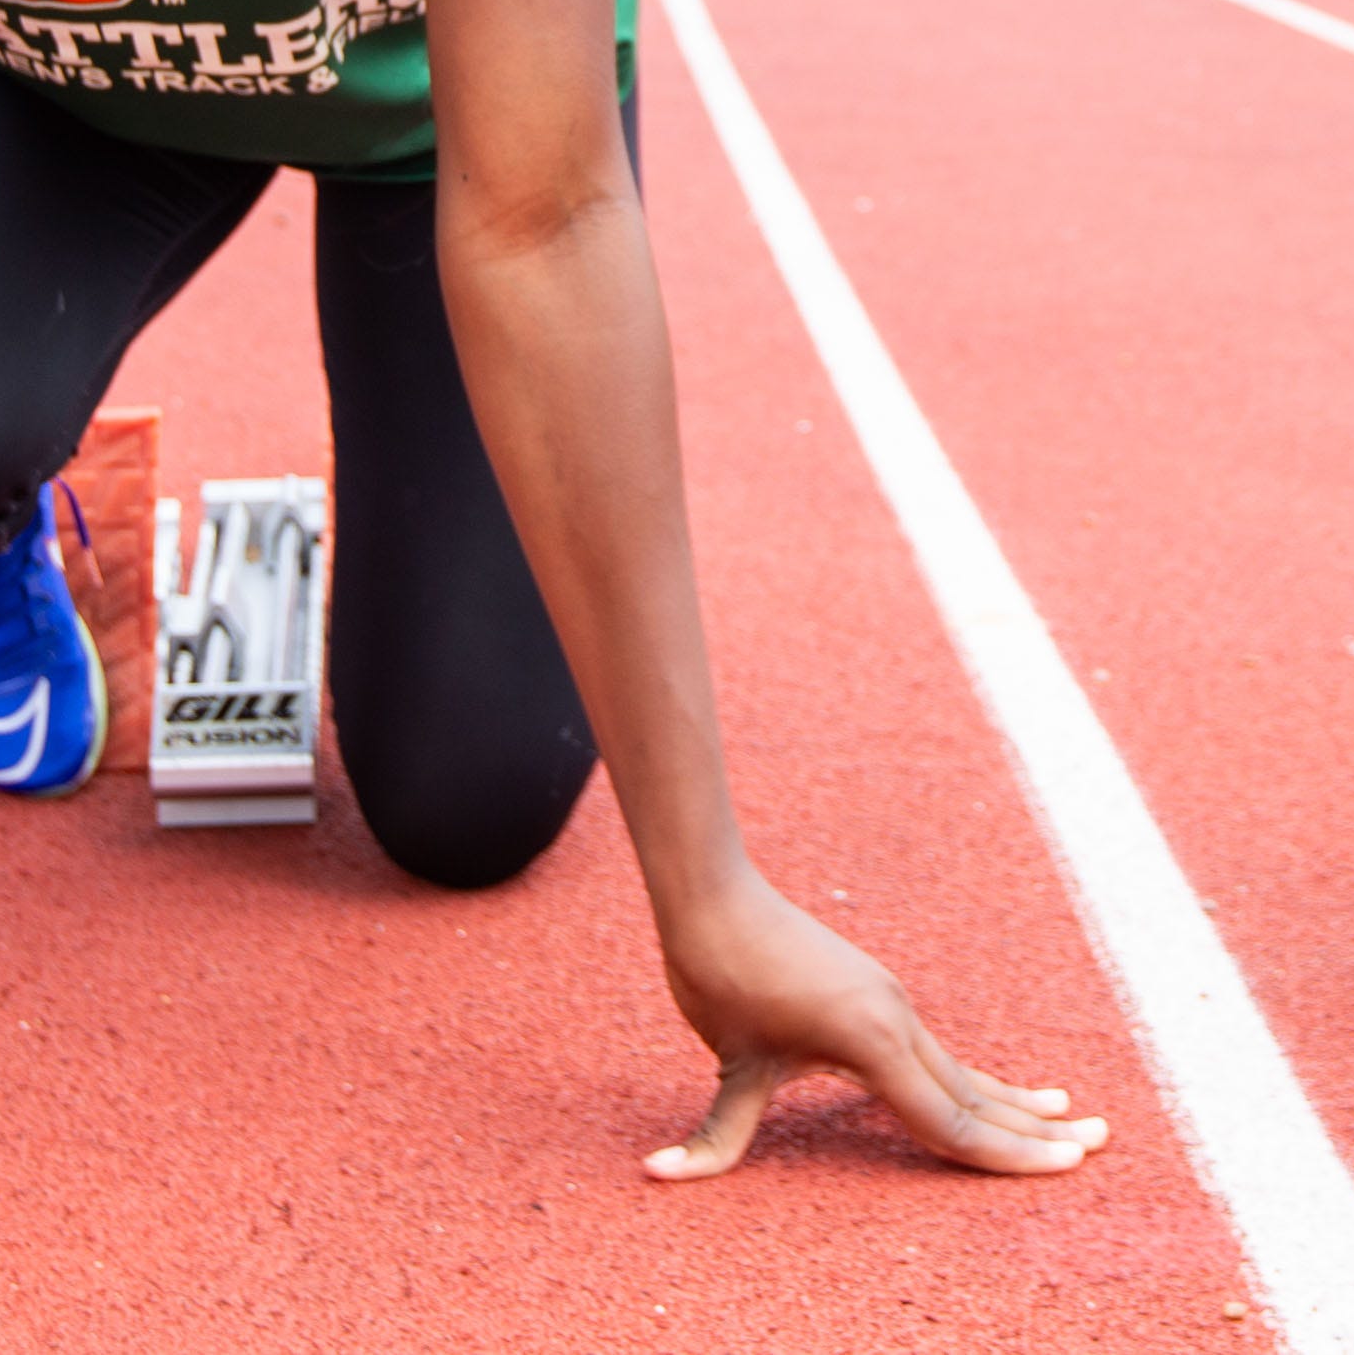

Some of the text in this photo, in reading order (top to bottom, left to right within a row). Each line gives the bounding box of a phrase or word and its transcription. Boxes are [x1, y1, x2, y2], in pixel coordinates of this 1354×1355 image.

[121, 68, 293, 96] TRACK
[306, 64, 340, 94] &
[164, 692, 301, 723] GILL
